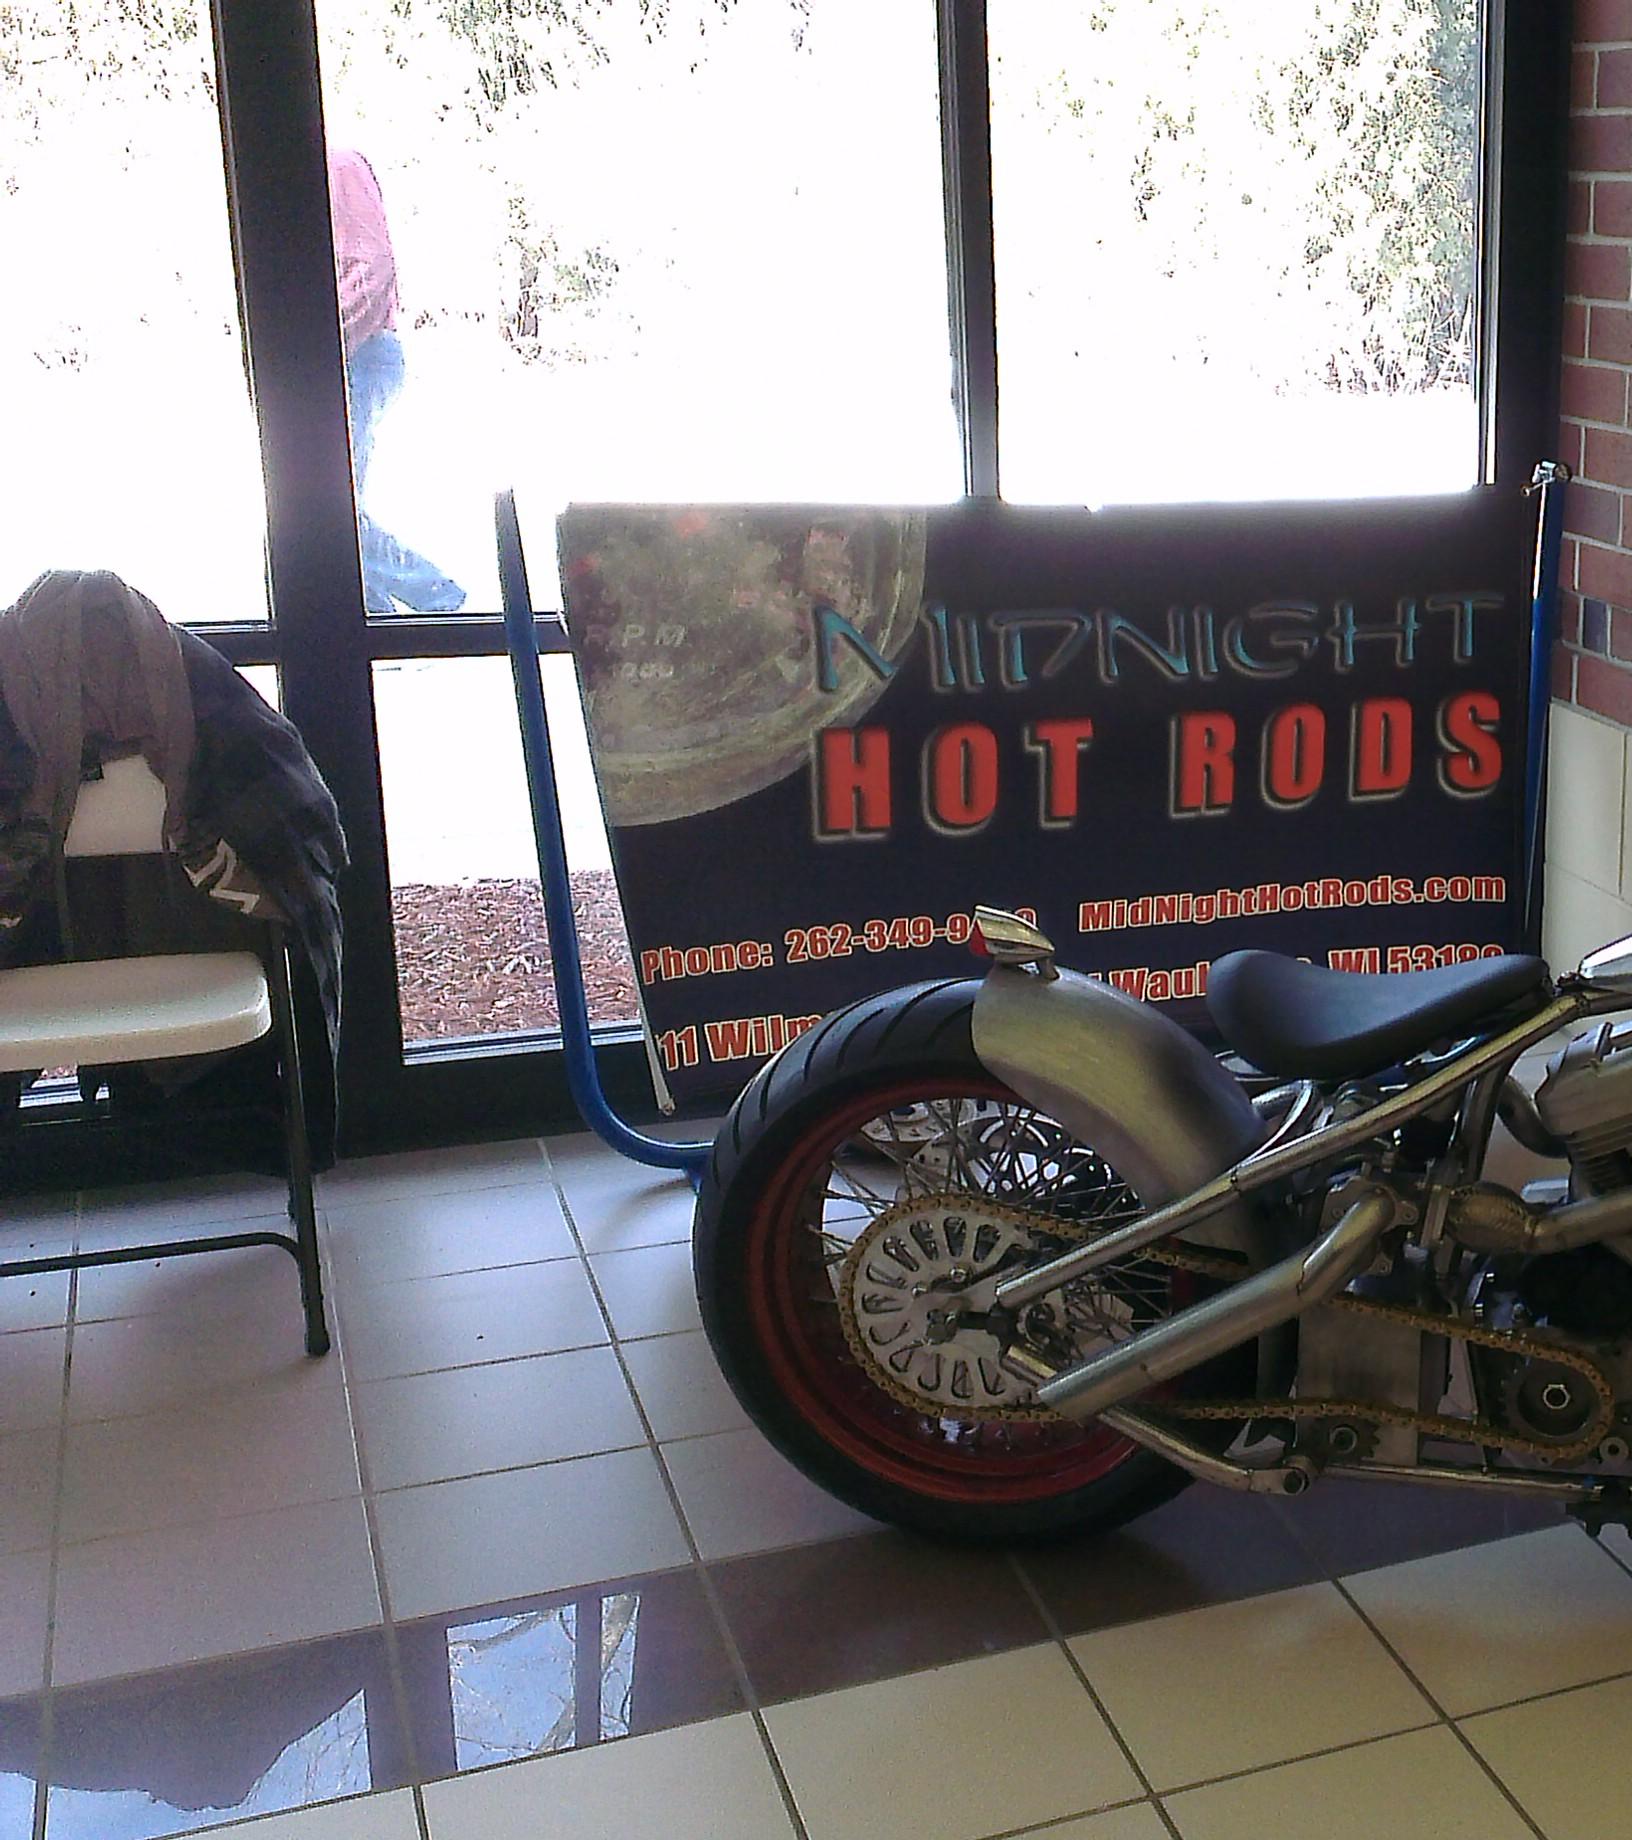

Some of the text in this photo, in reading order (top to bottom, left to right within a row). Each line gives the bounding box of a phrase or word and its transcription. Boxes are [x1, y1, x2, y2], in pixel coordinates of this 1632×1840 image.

[810, 593, 1504, 692] MIDNIGHT
[811, 692, 1503, 843] HOT RODS
[642, 908, 1037, 985] Phone: 262-349-9
[1079, 876, 1506, 932] MidNightHotRods.com
